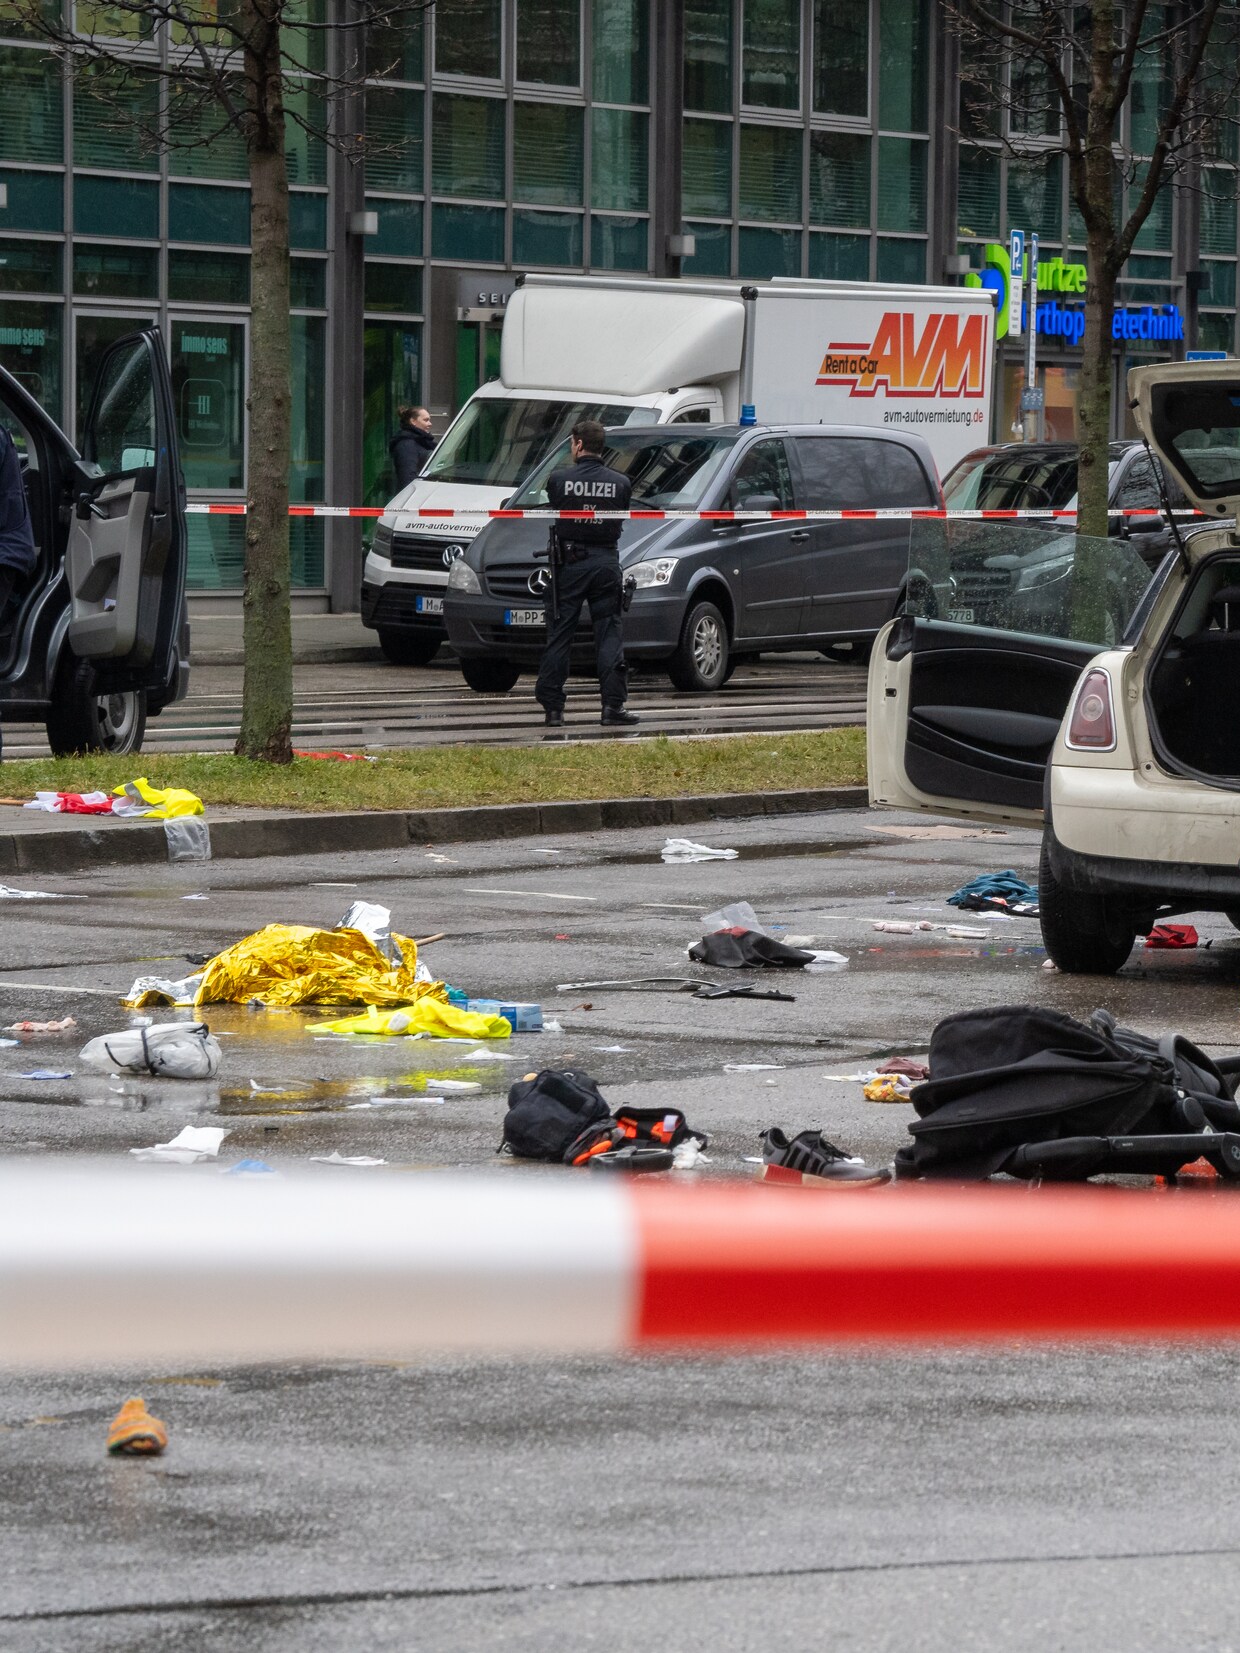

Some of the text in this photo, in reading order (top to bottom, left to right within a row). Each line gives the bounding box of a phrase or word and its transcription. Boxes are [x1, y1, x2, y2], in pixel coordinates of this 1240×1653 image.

[1022, 253, 1088, 293] urtze
[479, 292, 509, 304] SEI
[1022, 300, 1185, 345] rthopetechnik
[858, 312, 984, 389] AVM
[825, 355, 878, 374] Rent a Car
[883, 408, 984, 426] avm-autovermietung.de
[564, 480, 616, 498] POLIZEI
[524, 611, 538, 622] PP
